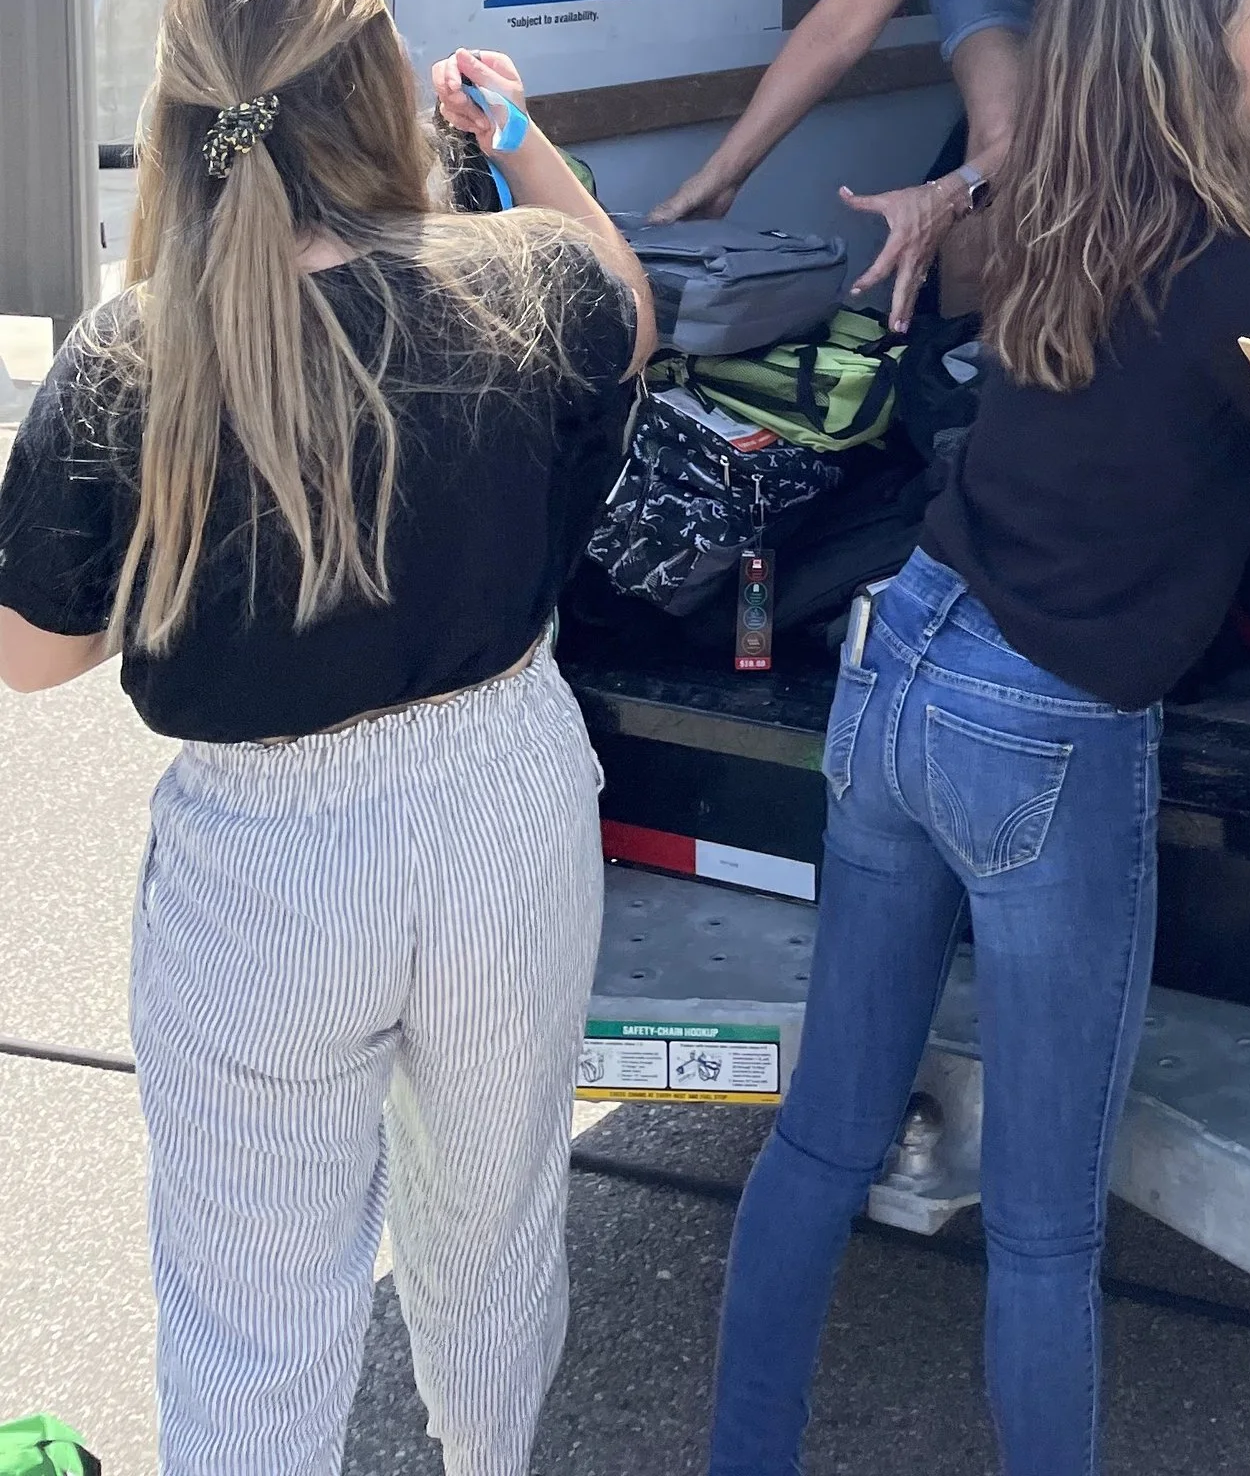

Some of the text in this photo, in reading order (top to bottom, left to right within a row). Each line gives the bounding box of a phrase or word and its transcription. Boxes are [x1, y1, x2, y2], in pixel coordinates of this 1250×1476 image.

[544, 13, 552, 24] to
[554, 10, 599, 24] availability.
[622, 1025, 719, 1037] SAFETY-CHAIN HOOKUP
